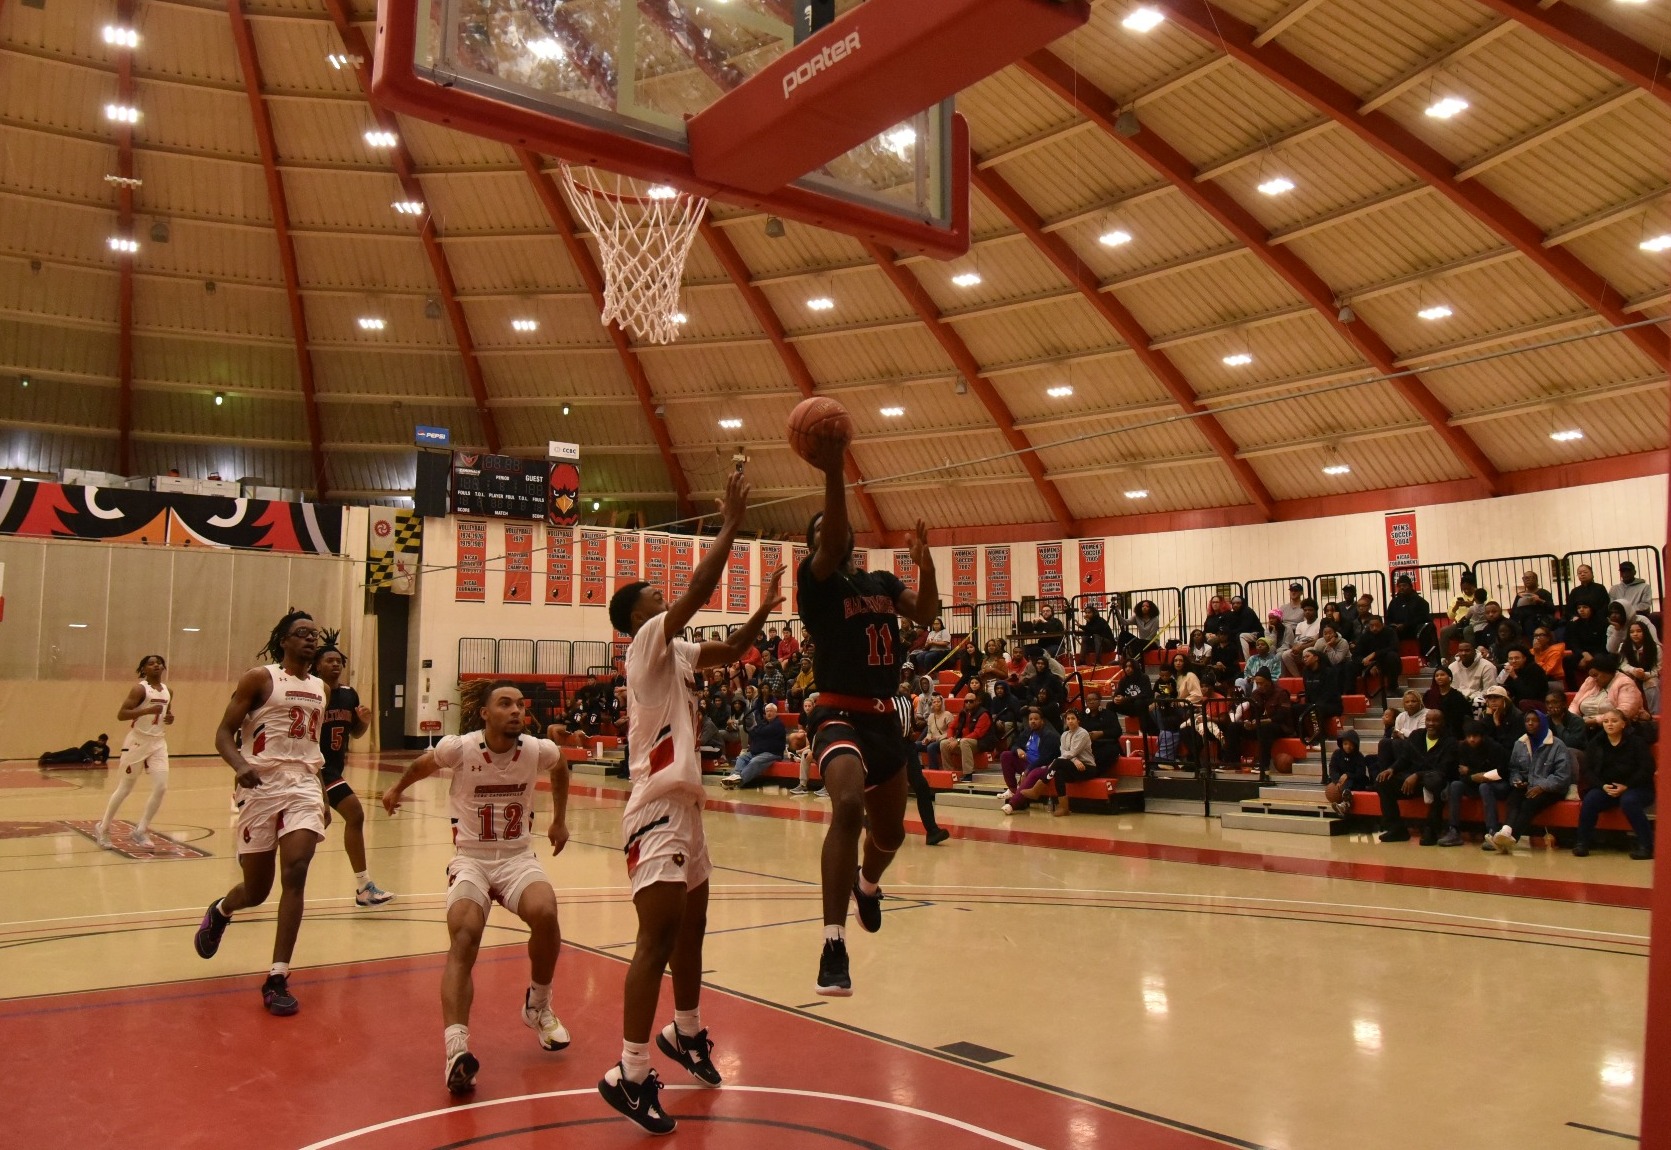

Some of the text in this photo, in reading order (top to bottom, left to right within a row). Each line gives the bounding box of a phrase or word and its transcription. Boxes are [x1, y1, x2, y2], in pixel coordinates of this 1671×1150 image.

[1391, 530, 1412, 539] SOCCER
[866, 624, 893, 665] 11
[288, 706, 321, 743] 24
[331, 727, 344, 751] 5
[478, 802, 523, 841] 12
